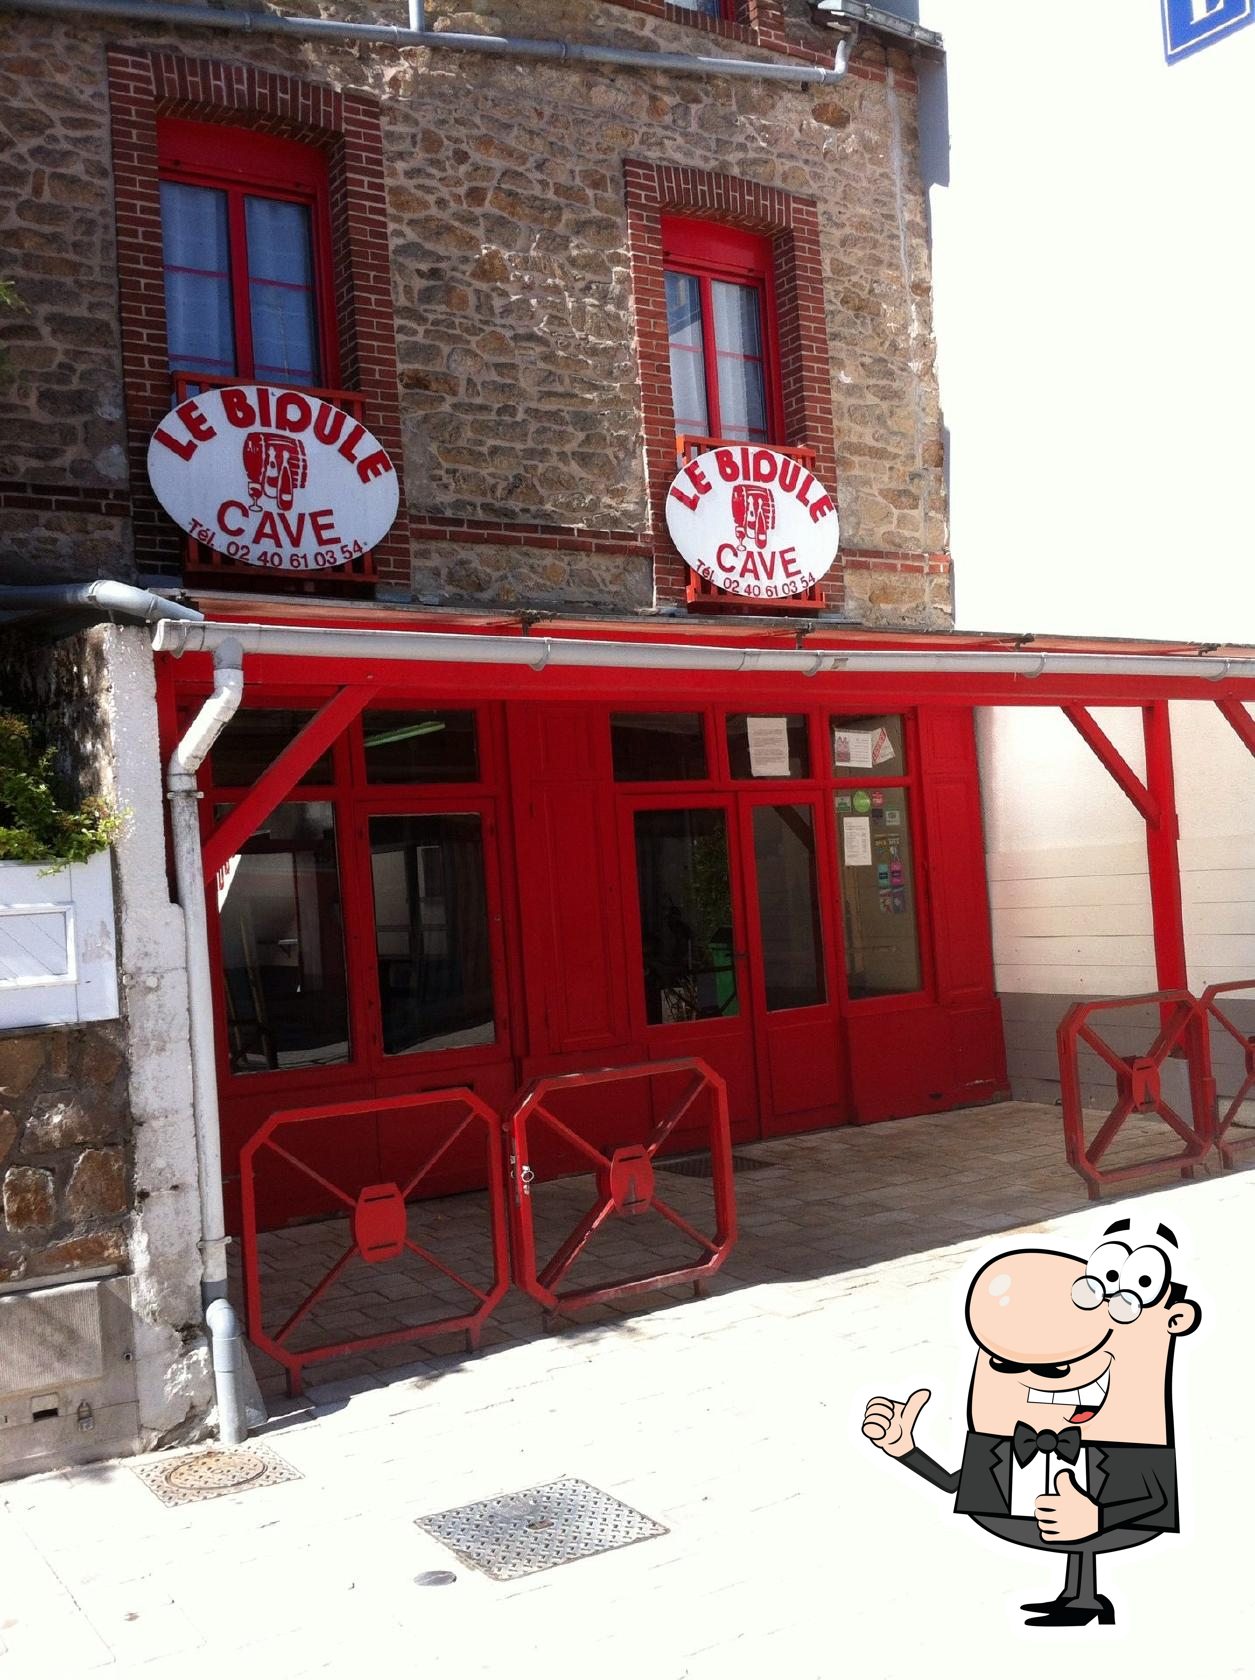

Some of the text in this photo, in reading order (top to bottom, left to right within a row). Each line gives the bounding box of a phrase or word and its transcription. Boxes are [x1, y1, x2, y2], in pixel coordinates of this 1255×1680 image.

[153, 387, 393, 484] LE BIDULE
[669, 447, 834, 524] LE BIDULE
[188, 517, 364, 569] Tél. 02 40 61 03 54
[217, 500, 342, 549] CAVE
[696, 558, 816, 598] Tél. 02 40 61 03 54
[717, 543, 802, 581] CAVE
